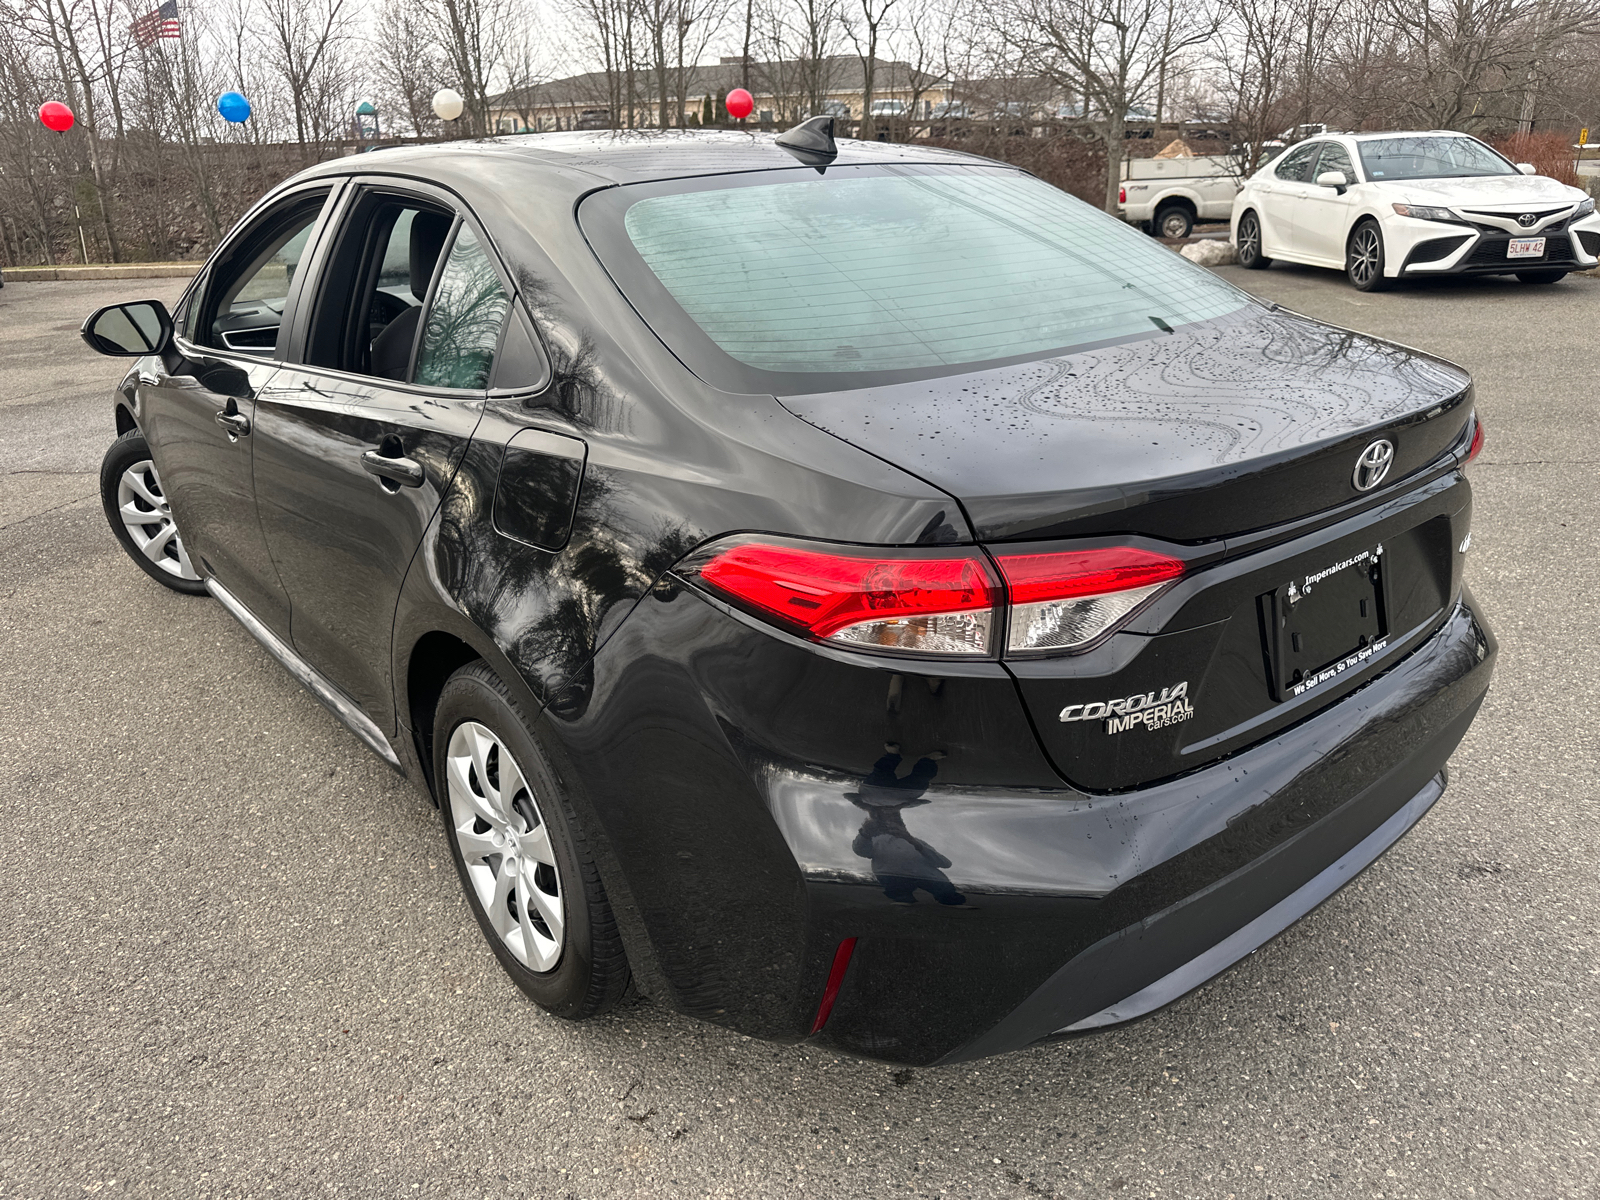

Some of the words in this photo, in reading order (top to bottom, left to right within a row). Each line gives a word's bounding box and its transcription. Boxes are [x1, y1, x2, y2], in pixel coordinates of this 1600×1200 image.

[1510, 243, 1530, 253] 5LHW
[1533, 242, 1543, 252] 42
[1305, 550, 1369, 586] Imperialcars.com
[1294, 685, 1305, 695] We
[1305, 676, 1318, 690] Sell
[1318, 668, 1337, 683] More,
[1337, 663, 1346, 673] So
[1346, 656, 1357, 667] You
[1357, 648, 1373, 662] Save
[1373, 641, 1386, 653] More
[1058, 681, 1188, 722] COROLLA
[1107, 697, 1194, 735] IMPERIAL
[1147, 710, 1193, 732] cars.com
